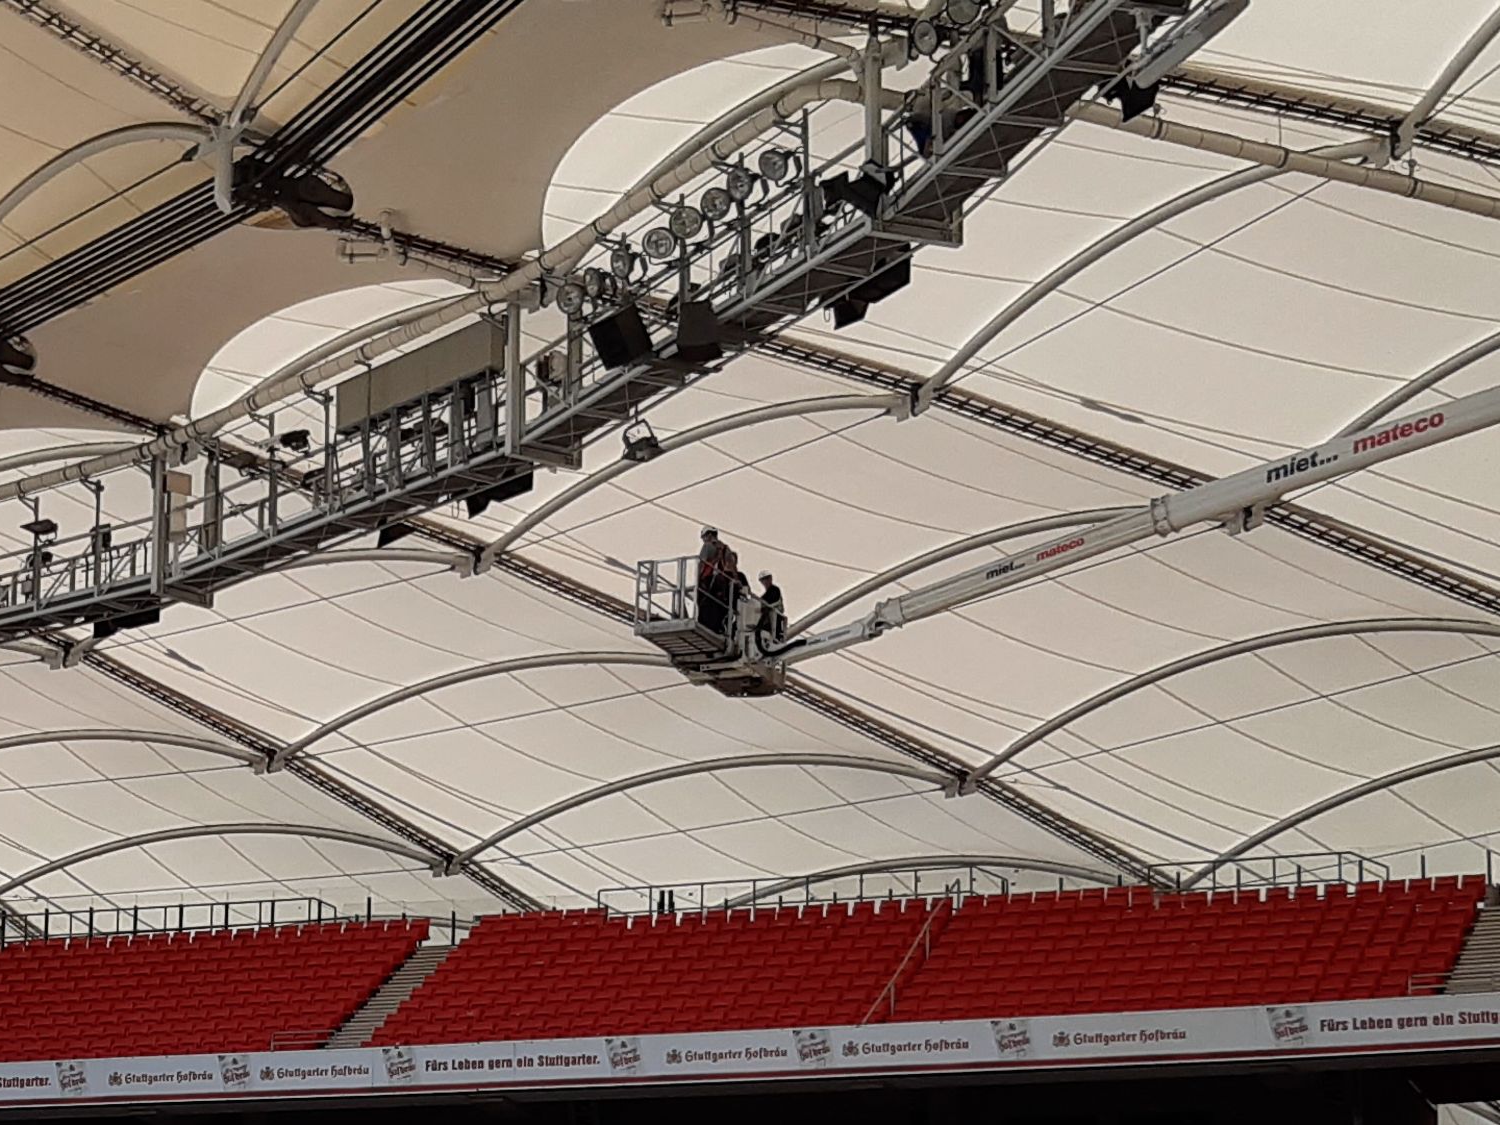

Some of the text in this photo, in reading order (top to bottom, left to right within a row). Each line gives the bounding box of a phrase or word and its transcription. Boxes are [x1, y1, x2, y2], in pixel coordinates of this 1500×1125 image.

[1266, 413, 1444, 483] miet... mateco
[1036, 538, 1084, 561] mateco
[1320, 1011, 1500, 1033] Fürs Leben gern ein Stuttg
[1073, 1029, 1187, 1046] Stuttgarter Hofbräu
[861, 1038, 969, 1055] Stuttgarter Hofbräu
[425, 1055, 600, 1072] Fürs Leben gern ein Stuttgarter.
[684, 1050, 741, 1063] Stuttgarter
[124, 1073, 174, 1085] Stuttgarter
[277, 1068, 328, 1080] Stuttgarter
